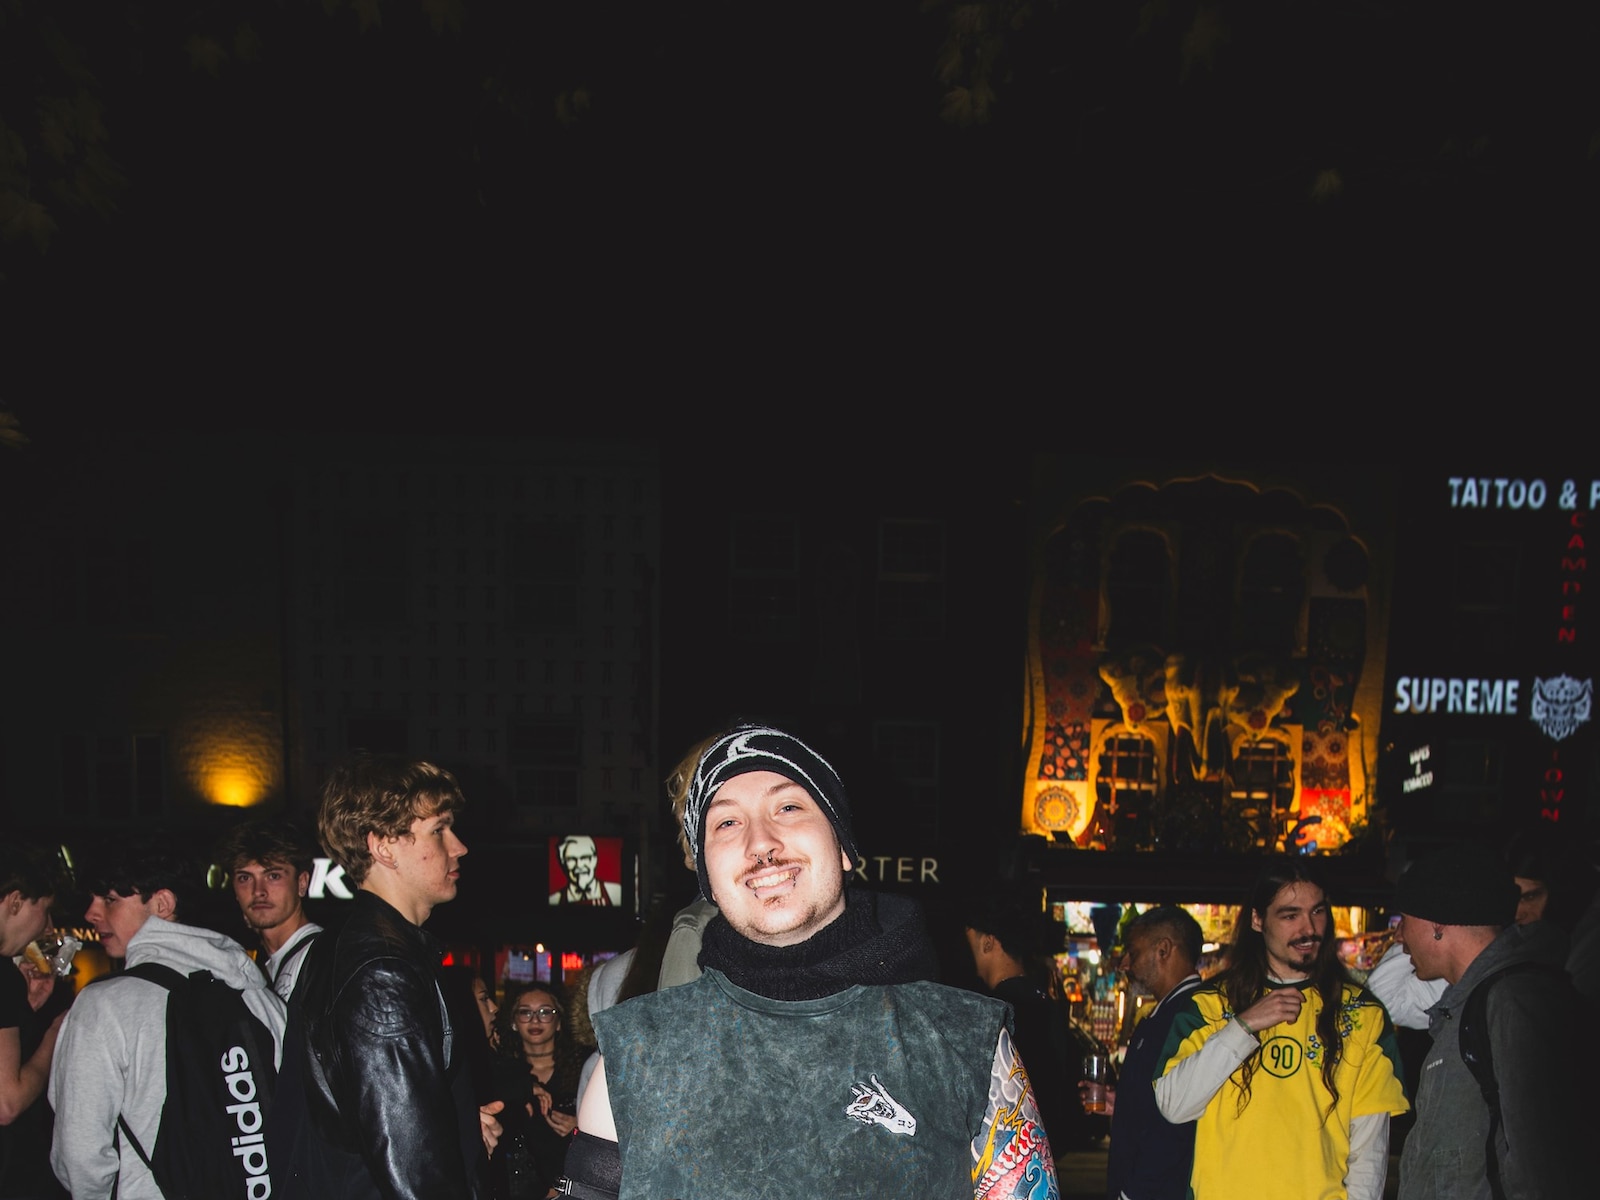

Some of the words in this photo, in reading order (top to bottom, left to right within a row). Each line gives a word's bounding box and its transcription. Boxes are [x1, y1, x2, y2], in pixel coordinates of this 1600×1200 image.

[1448, 477, 1547, 510] TATTOO
[1558, 479, 1578, 510] &
[1558, 511, 1587, 643] CAMDEN
[1394, 675, 1520, 716] SUPREME
[1270, 1043, 1294, 1070] 90
[897, 1118, 915, 1129] コン
